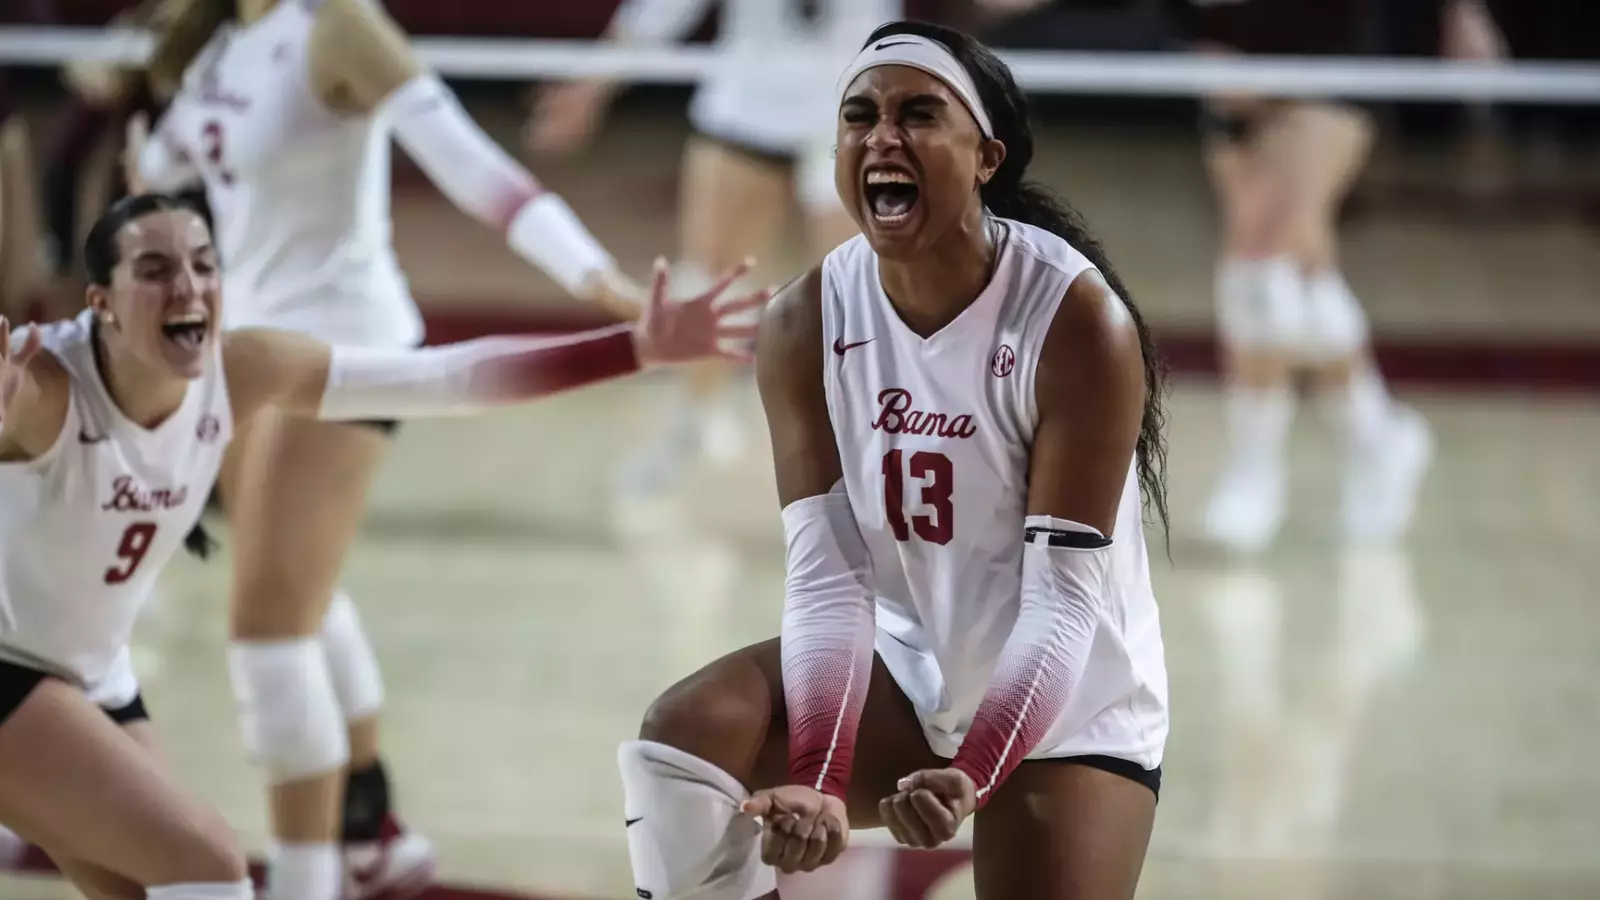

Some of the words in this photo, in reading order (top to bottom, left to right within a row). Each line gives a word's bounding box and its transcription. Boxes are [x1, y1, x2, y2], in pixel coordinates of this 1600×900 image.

[993, 345, 1014, 376] SEC
[871, 387, 977, 439] Bama
[882, 449, 954, 546] 13
[103, 522, 157, 585] 9
